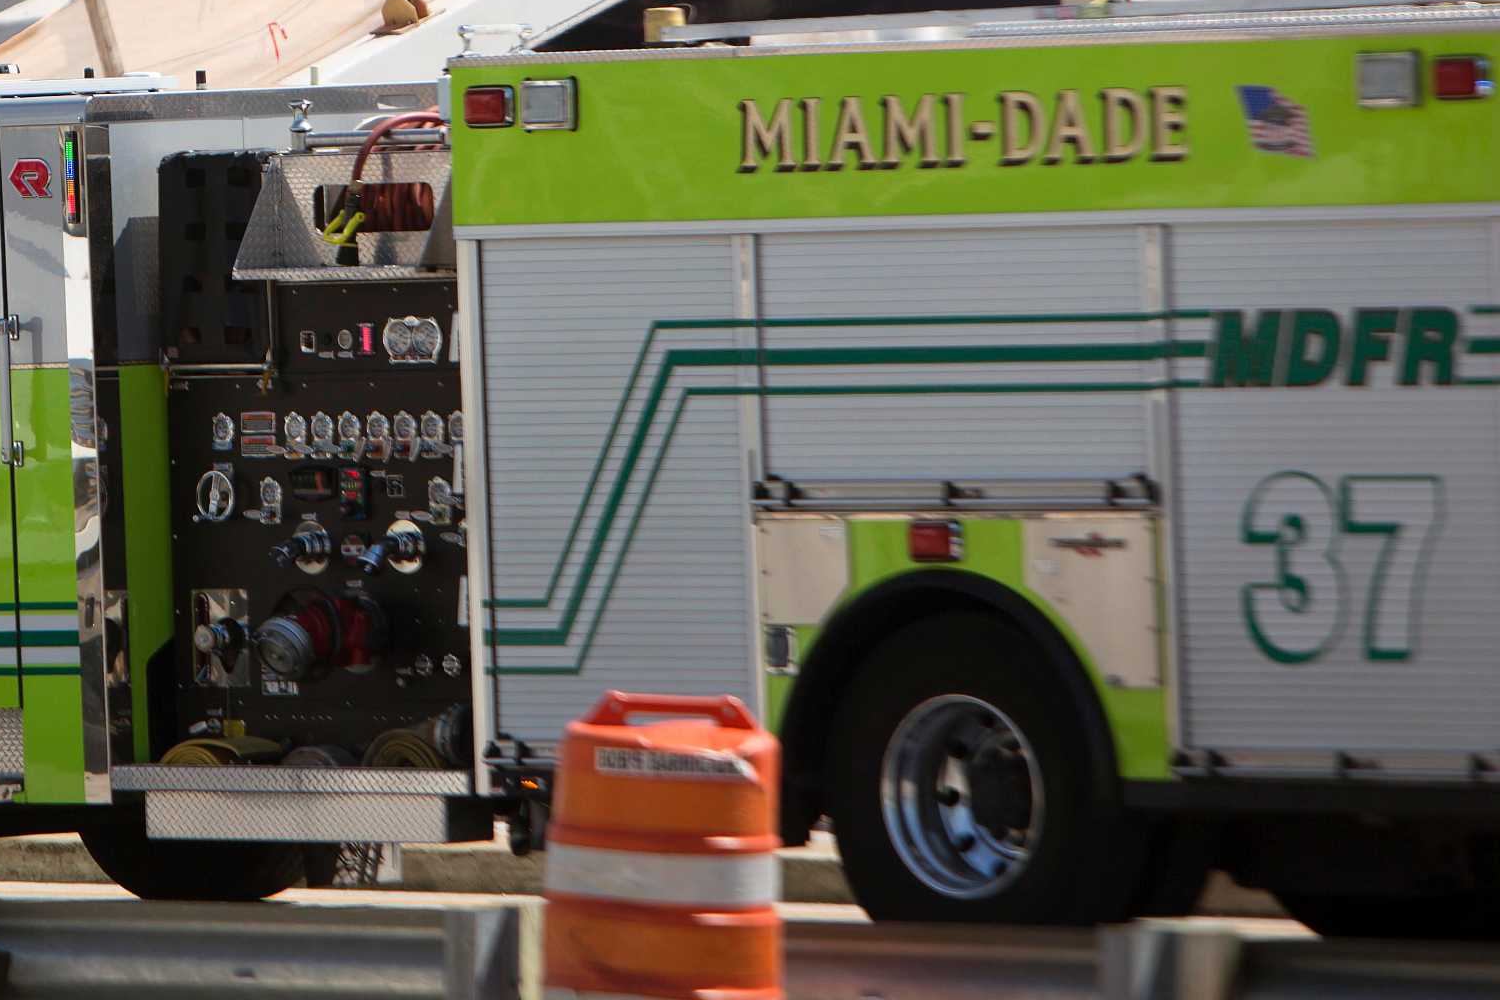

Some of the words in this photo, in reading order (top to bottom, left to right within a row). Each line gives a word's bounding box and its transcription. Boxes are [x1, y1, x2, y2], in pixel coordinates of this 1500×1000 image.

[736, 84, 1190, 173] MIAMI-DADE
[1212, 306, 1460, 388] MDFR
[1241, 469, 1446, 665] 37
